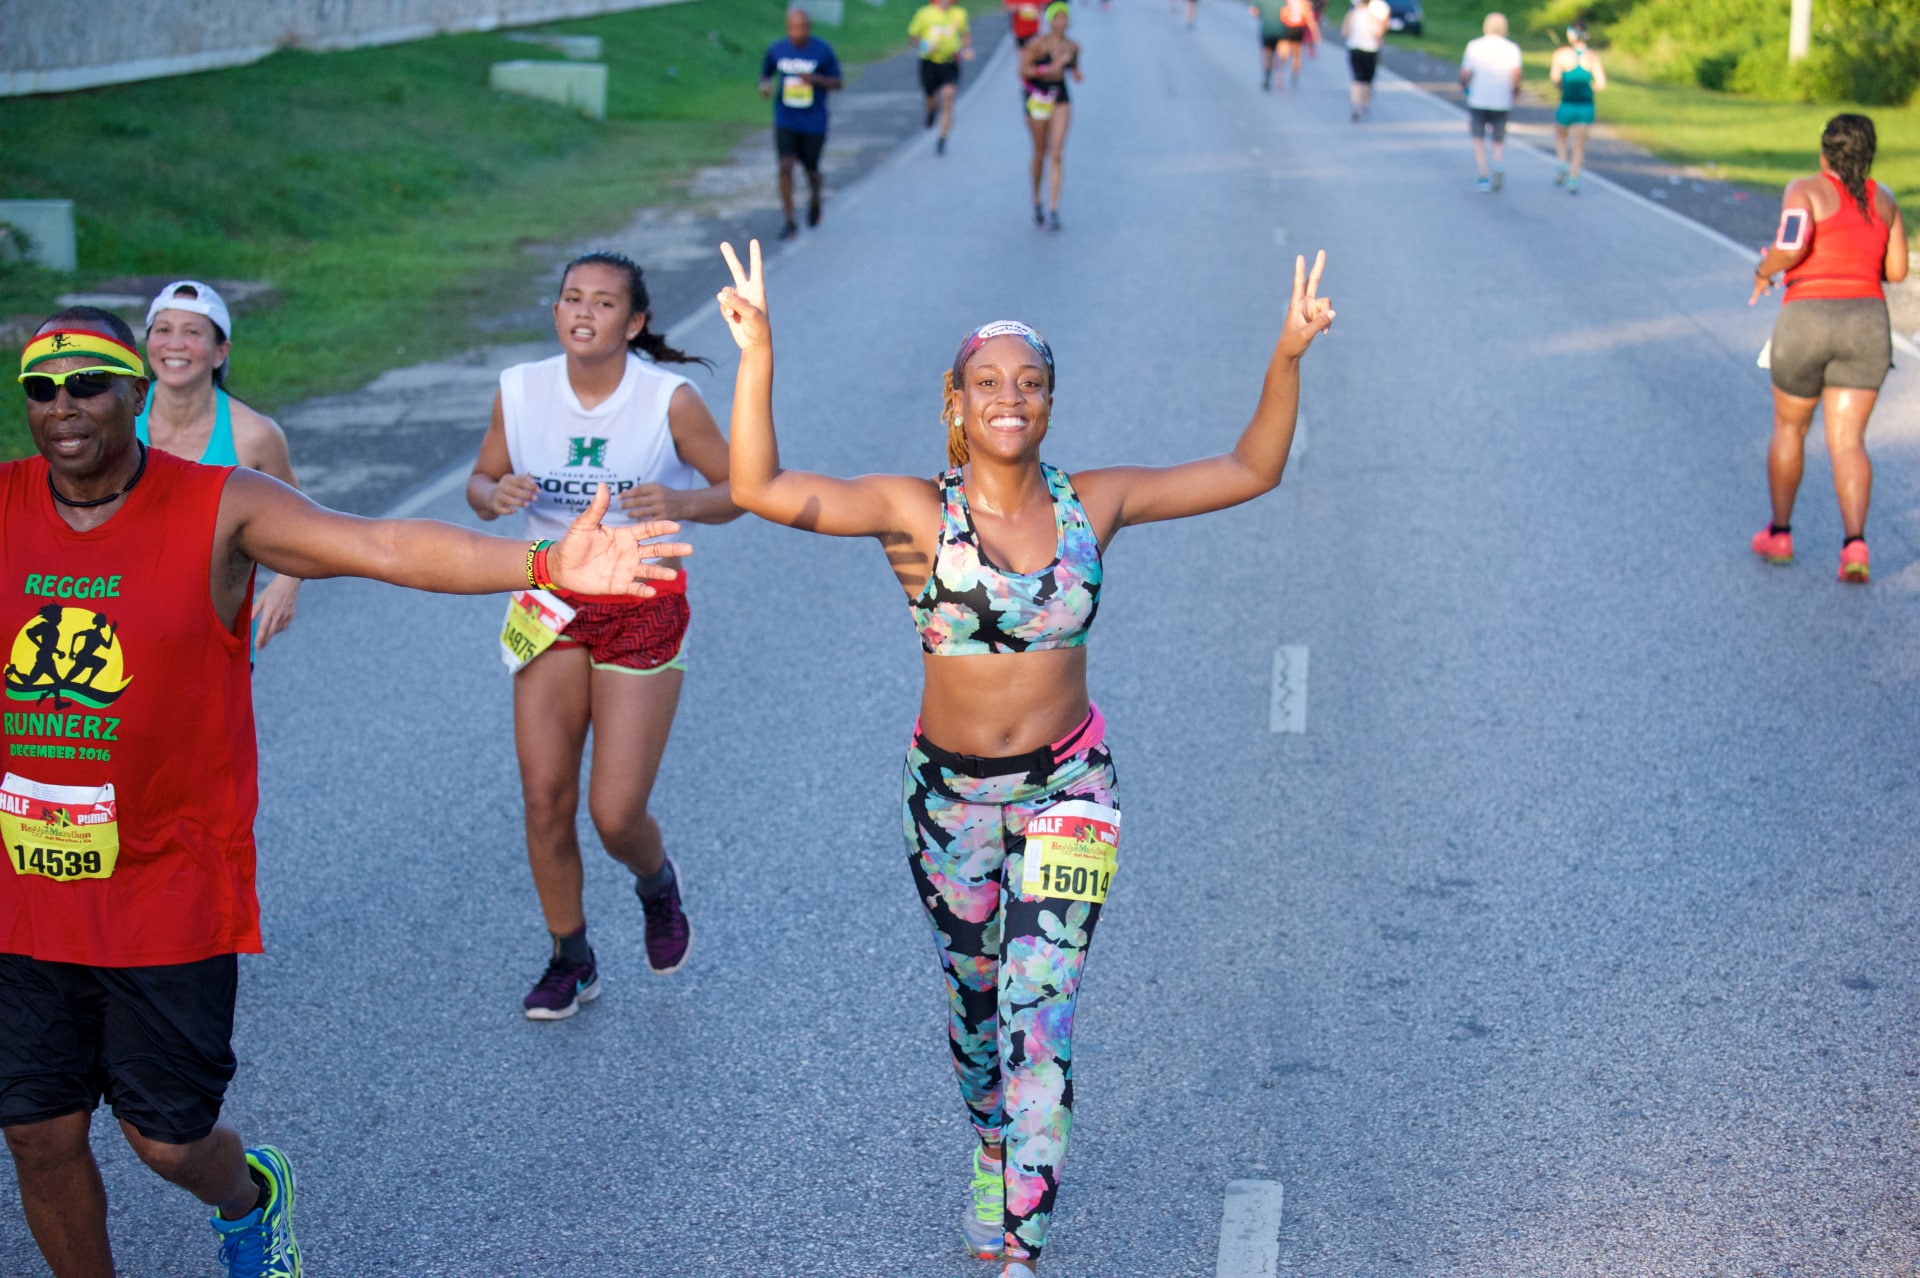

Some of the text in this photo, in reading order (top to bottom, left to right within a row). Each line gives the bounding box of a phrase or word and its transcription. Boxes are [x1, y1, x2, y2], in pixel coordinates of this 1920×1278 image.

[526, 551, 536, 585] STRONG
[24, 573, 122, 598] REGGAE
[3, 712, 121, 741] RUNNERZ
[9, 743, 111, 761] DECEMBER 2016
[0, 792, 30, 815] HALF
[1028, 818, 1063, 833] HALF
[14, 844, 101, 877] 14539
[1040, 864, 1109, 898] 15014
